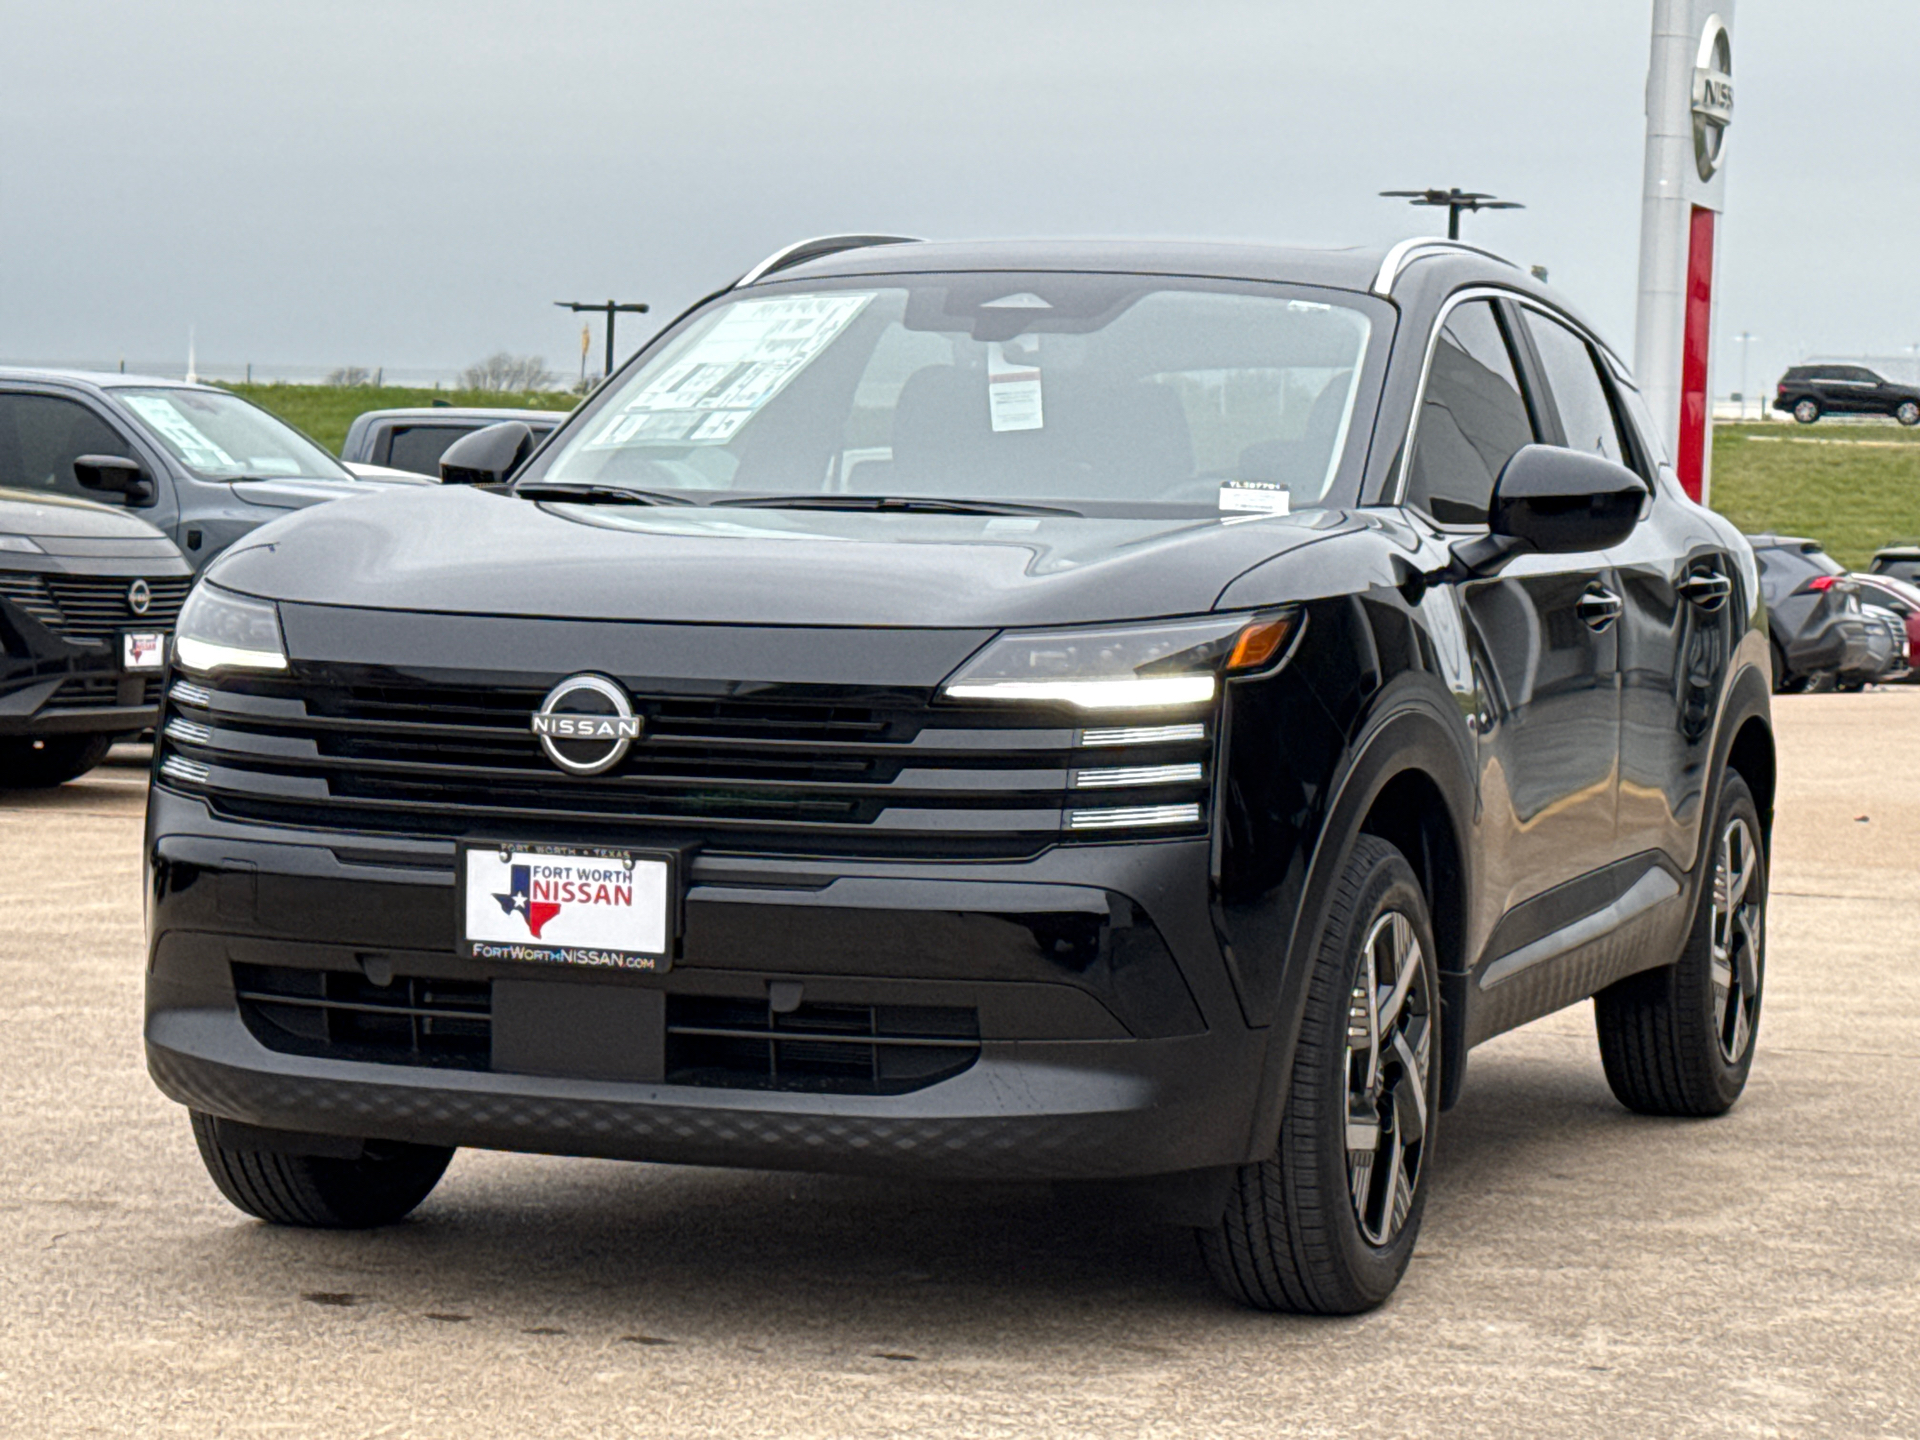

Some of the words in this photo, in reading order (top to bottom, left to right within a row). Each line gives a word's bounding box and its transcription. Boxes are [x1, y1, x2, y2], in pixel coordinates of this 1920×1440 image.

[533, 717, 636, 736] NISSAN
[501, 843, 529, 853] FORT
[535, 846, 576, 856] WORTH
[594, 850, 631, 860] TEXAS
[532, 865, 572, 880] FORT
[577, 868, 633, 884] WORTH
[532, 879, 633, 907] NISSAN
